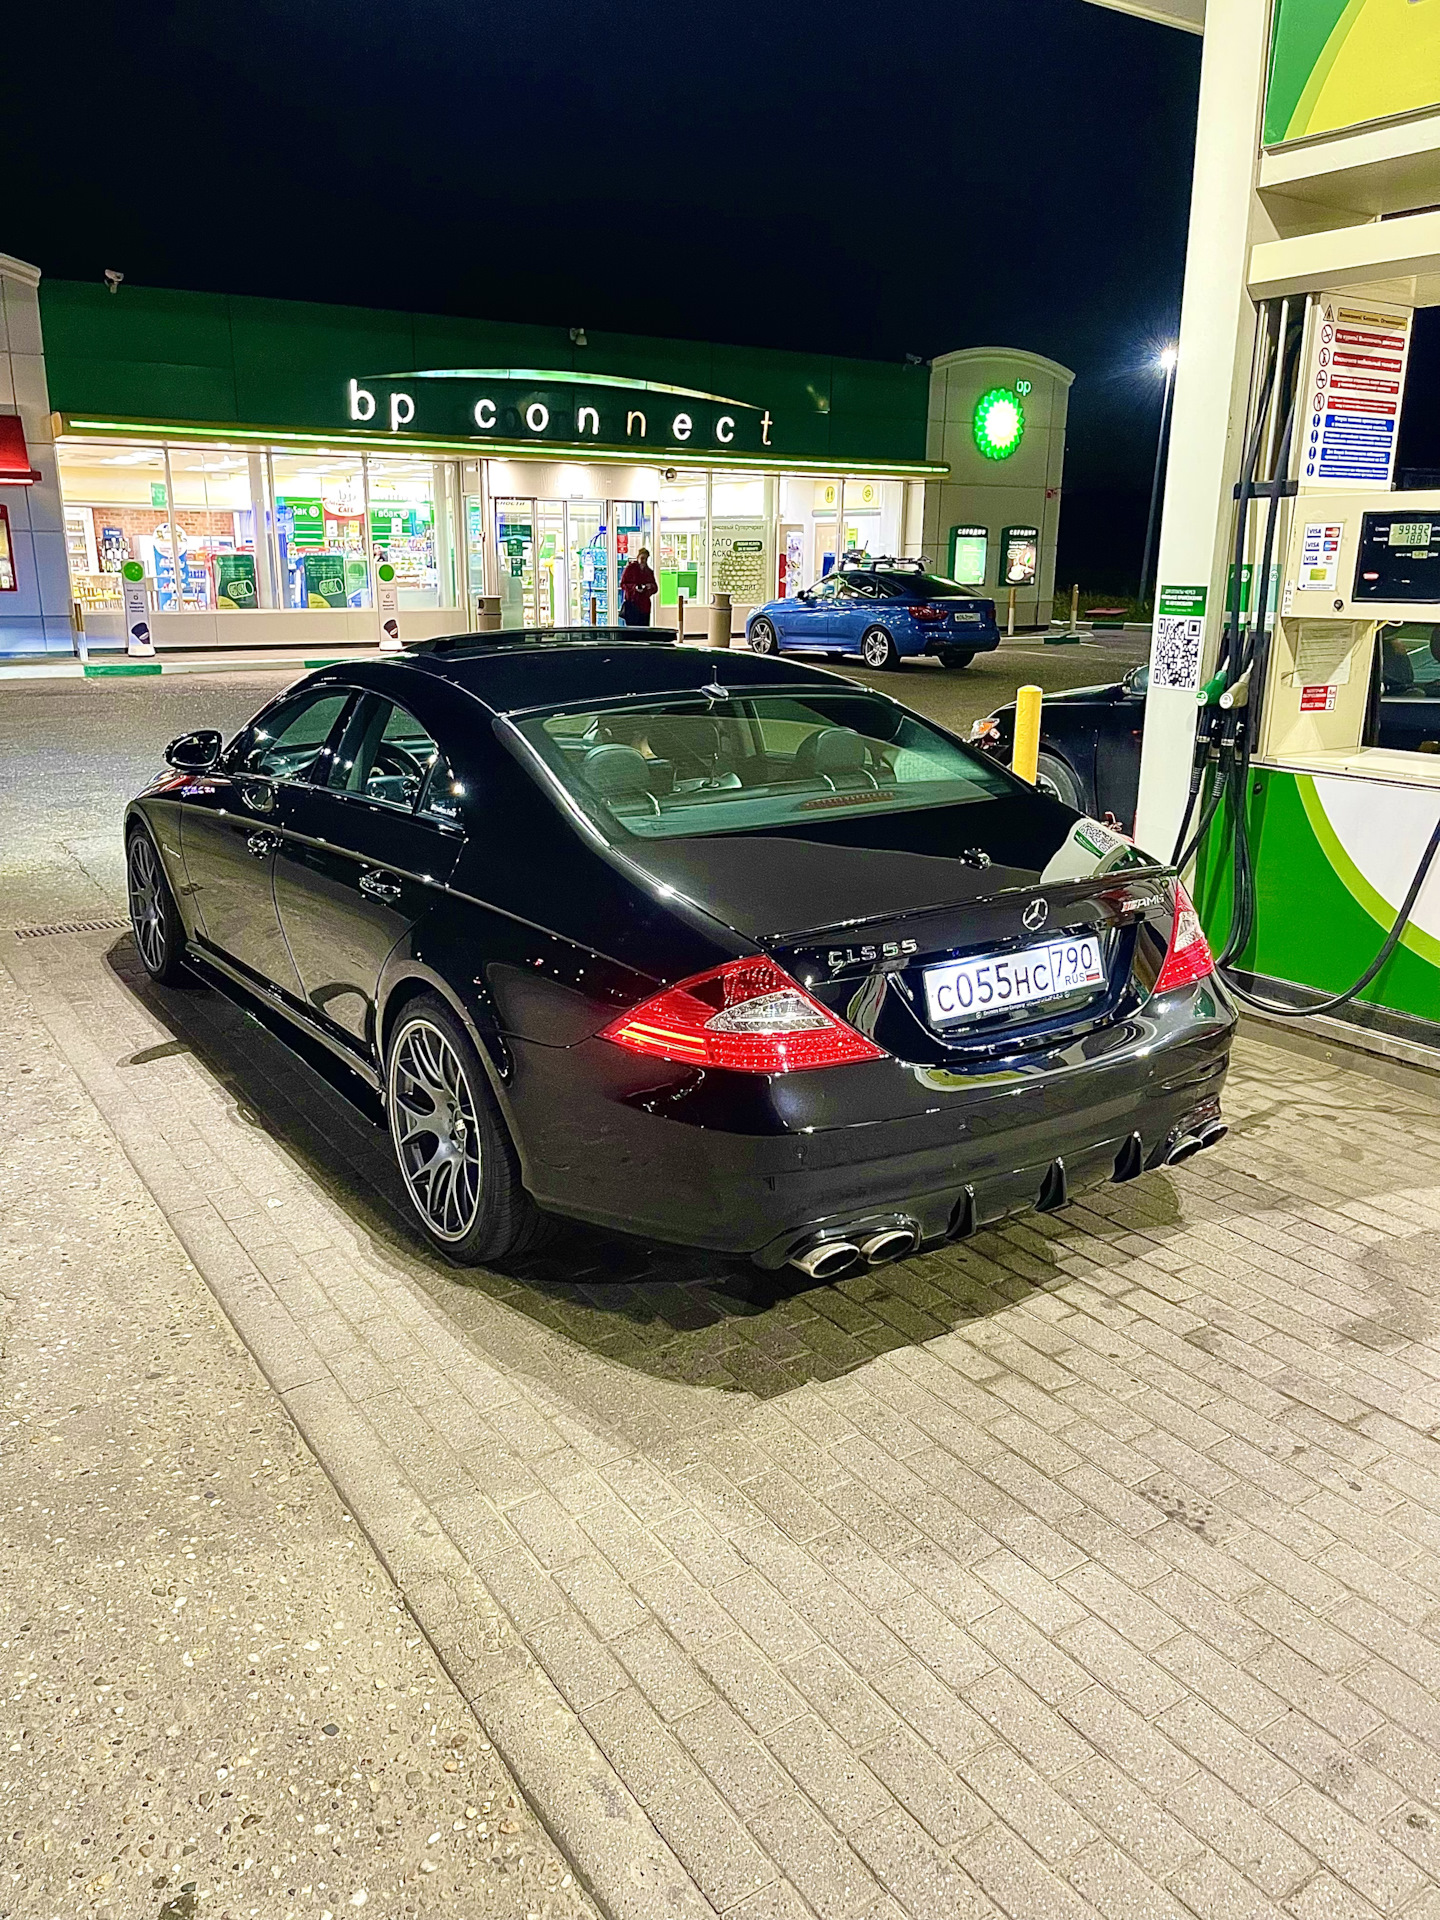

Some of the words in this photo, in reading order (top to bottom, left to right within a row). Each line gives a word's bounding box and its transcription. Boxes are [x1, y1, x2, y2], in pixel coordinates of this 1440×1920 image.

[1016, 377, 1031, 396] bp
[349, 378, 416, 433] bp
[473, 398, 773, 447] connect
[293, 505, 307, 516] бак
[373, 508, 399, 518] Табак
[712, 550, 732, 558] АСКО
[827, 945, 877, 967] CLS
[883, 939, 918, 957] 55
[1052, 943, 1093, 978] 790
[1065, 972, 1086, 986] RUS
